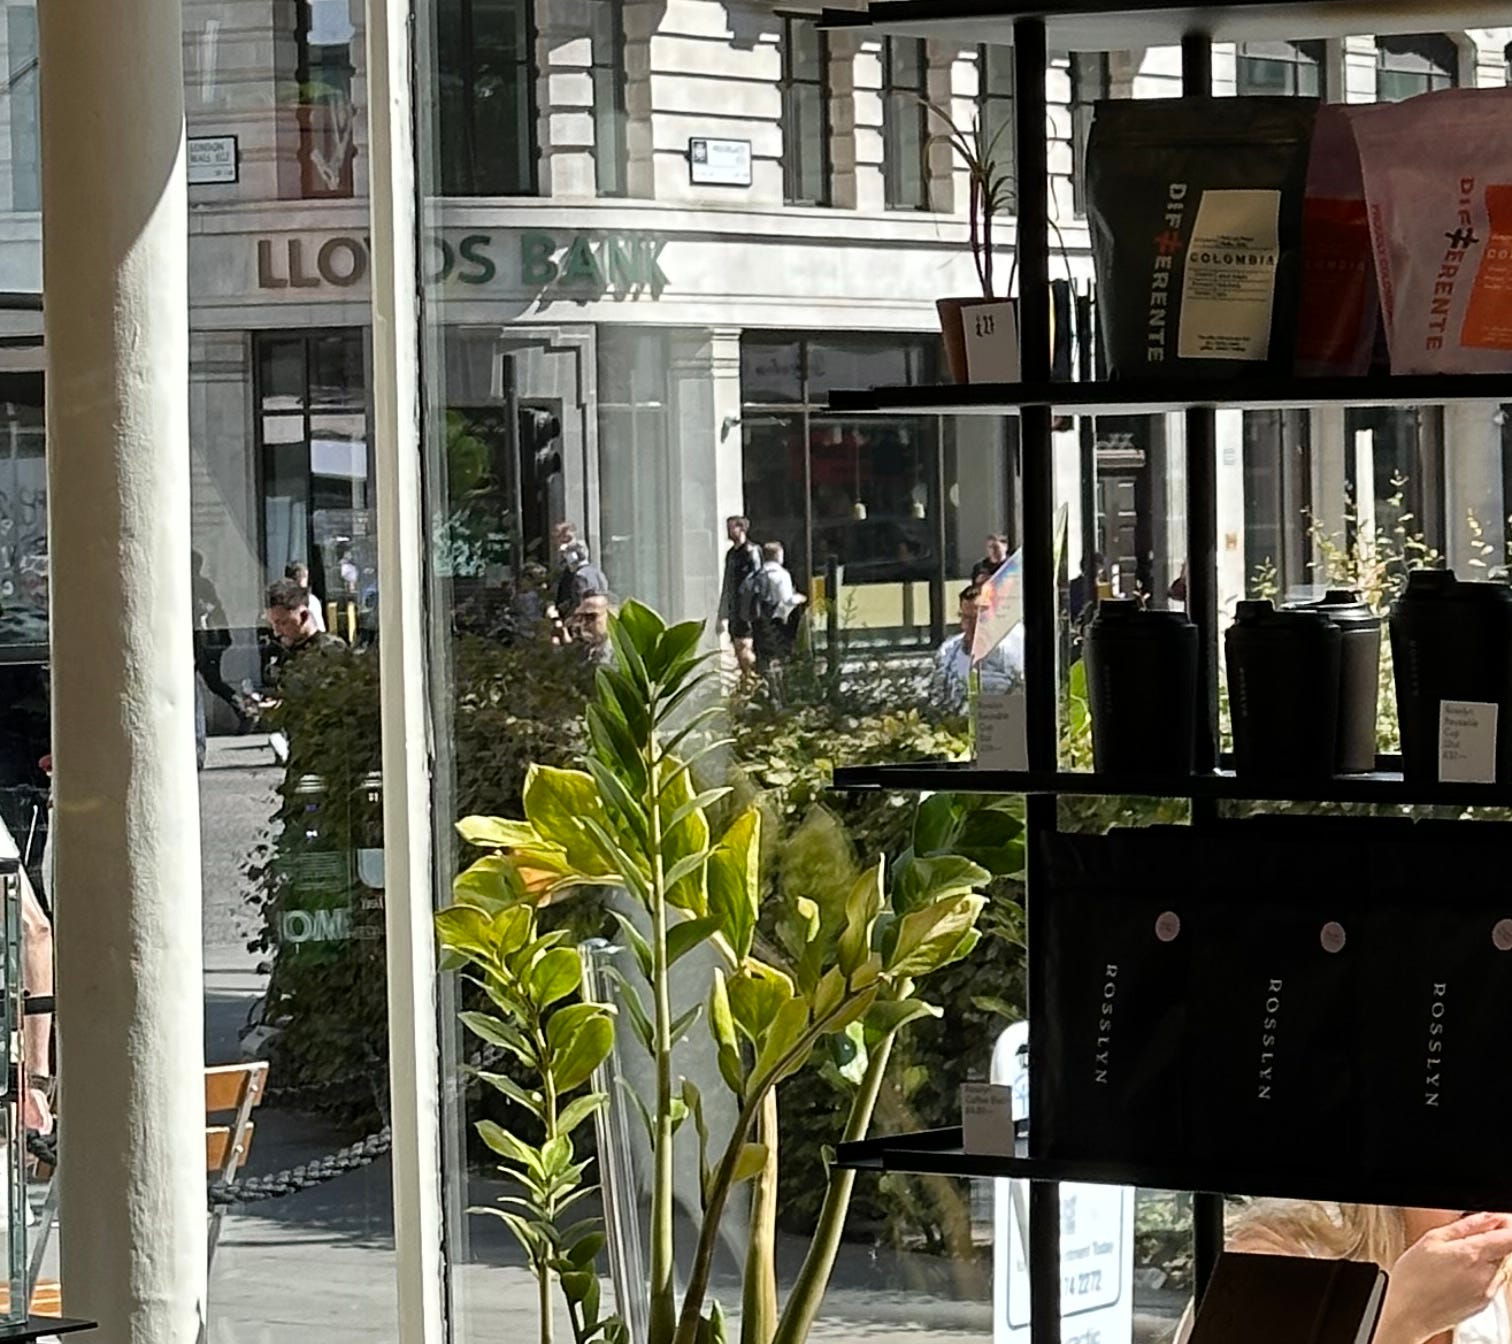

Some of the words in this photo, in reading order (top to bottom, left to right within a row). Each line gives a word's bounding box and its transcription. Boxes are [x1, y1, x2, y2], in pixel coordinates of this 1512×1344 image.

[1190, 252, 1275, 266] COLOMBIA
[1095, 962, 1119, 1084] ROSSLYN
[1258, 977, 1283, 1100] ROSSLYN
[1425, 982, 1447, 1107] ROSSLYN
